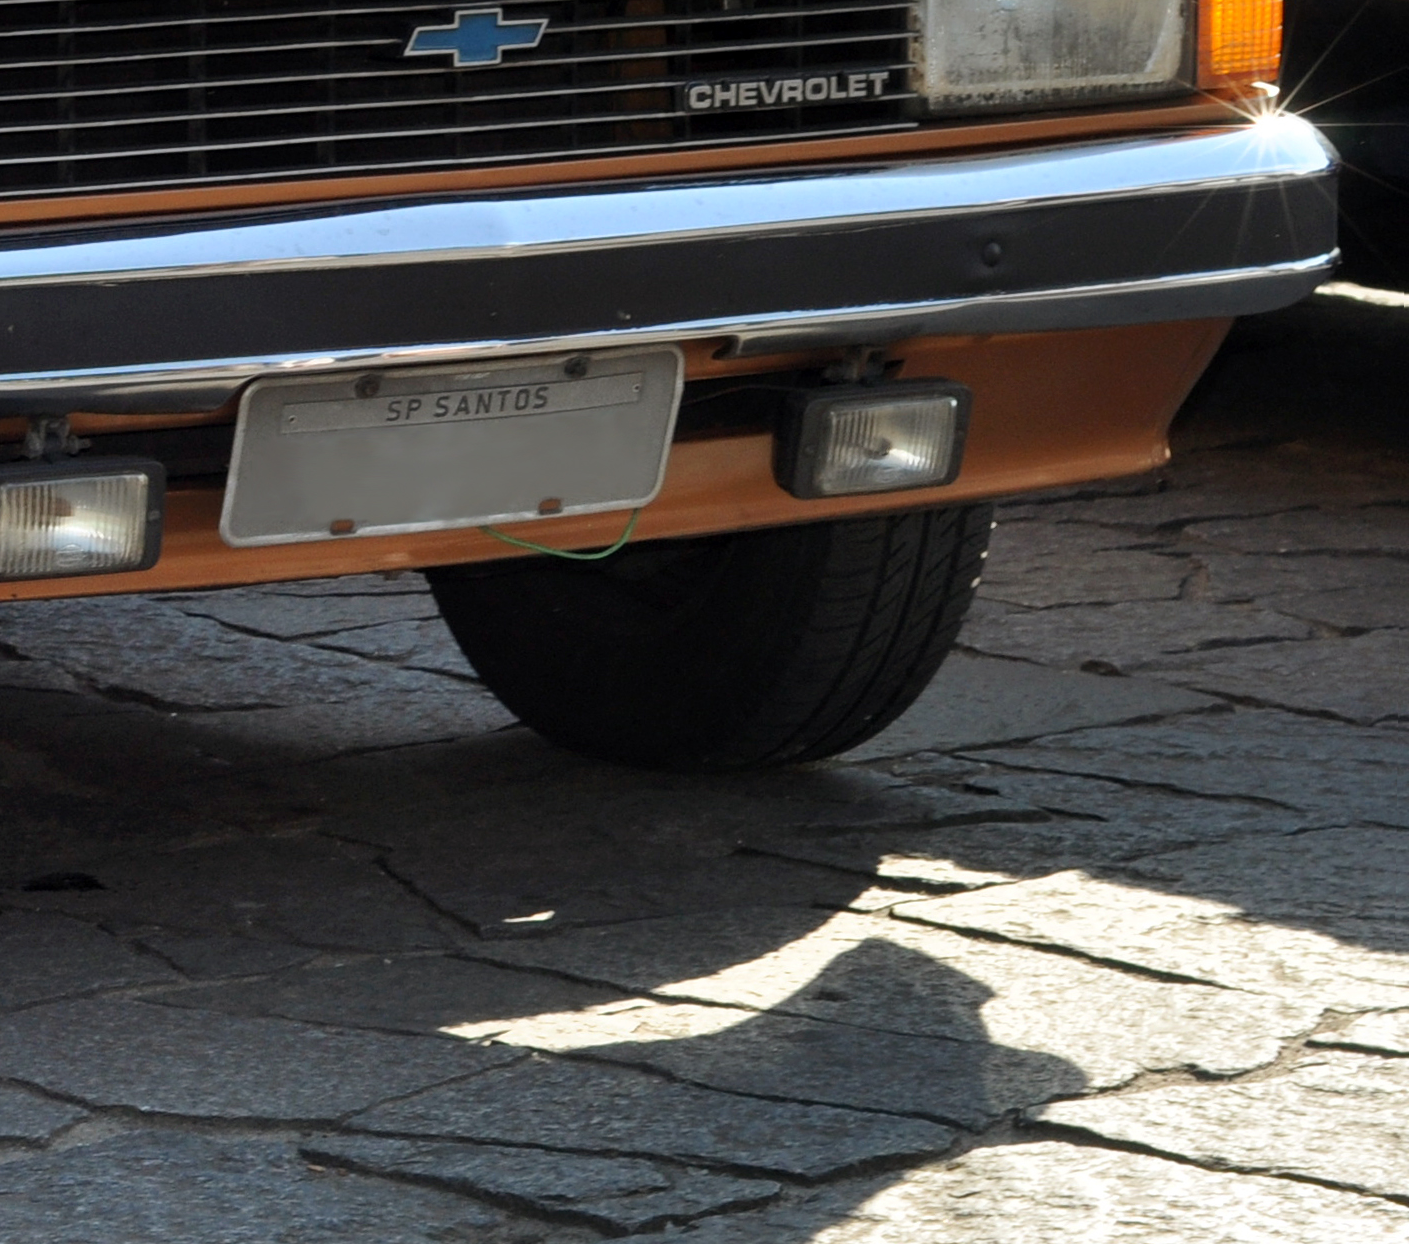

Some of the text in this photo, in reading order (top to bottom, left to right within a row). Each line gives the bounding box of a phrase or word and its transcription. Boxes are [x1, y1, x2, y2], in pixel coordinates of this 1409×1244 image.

[689, 71, 889, 109] CHEVROLET
[386, 387, 549, 421] SP SANTOS
